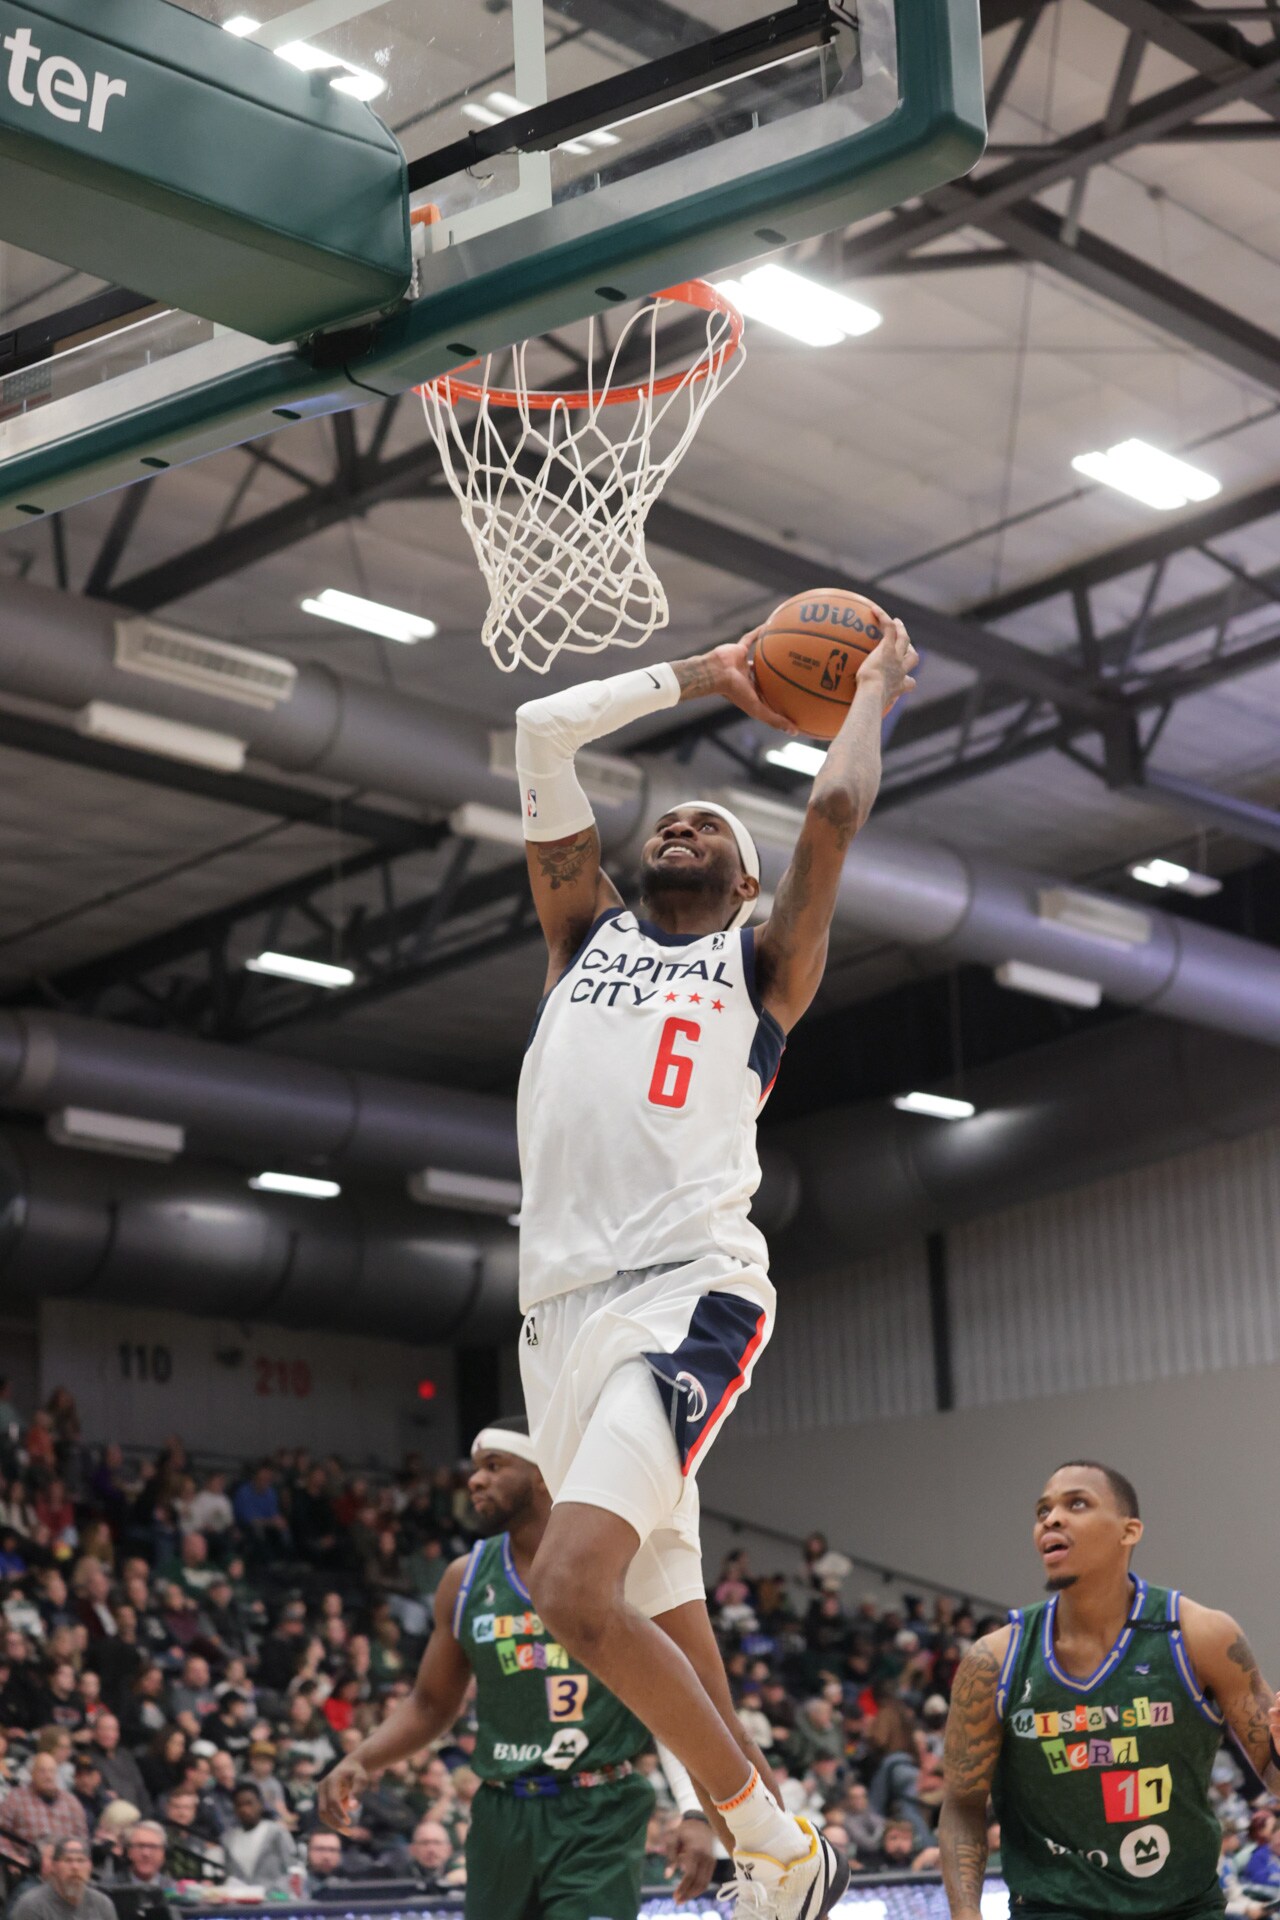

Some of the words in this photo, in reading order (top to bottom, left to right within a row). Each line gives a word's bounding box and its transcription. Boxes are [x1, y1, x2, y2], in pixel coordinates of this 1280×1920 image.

[0, 28, 127, 133] ter
[800, 603, 884, 640] Wilso
[582, 948, 733, 988] CAPITAL
[570, 978, 659, 1006] CITY
[648, 1016, 701, 1109] 6
[553, 1679, 579, 1717] 3
[493, 1743, 542, 1762] BMO
